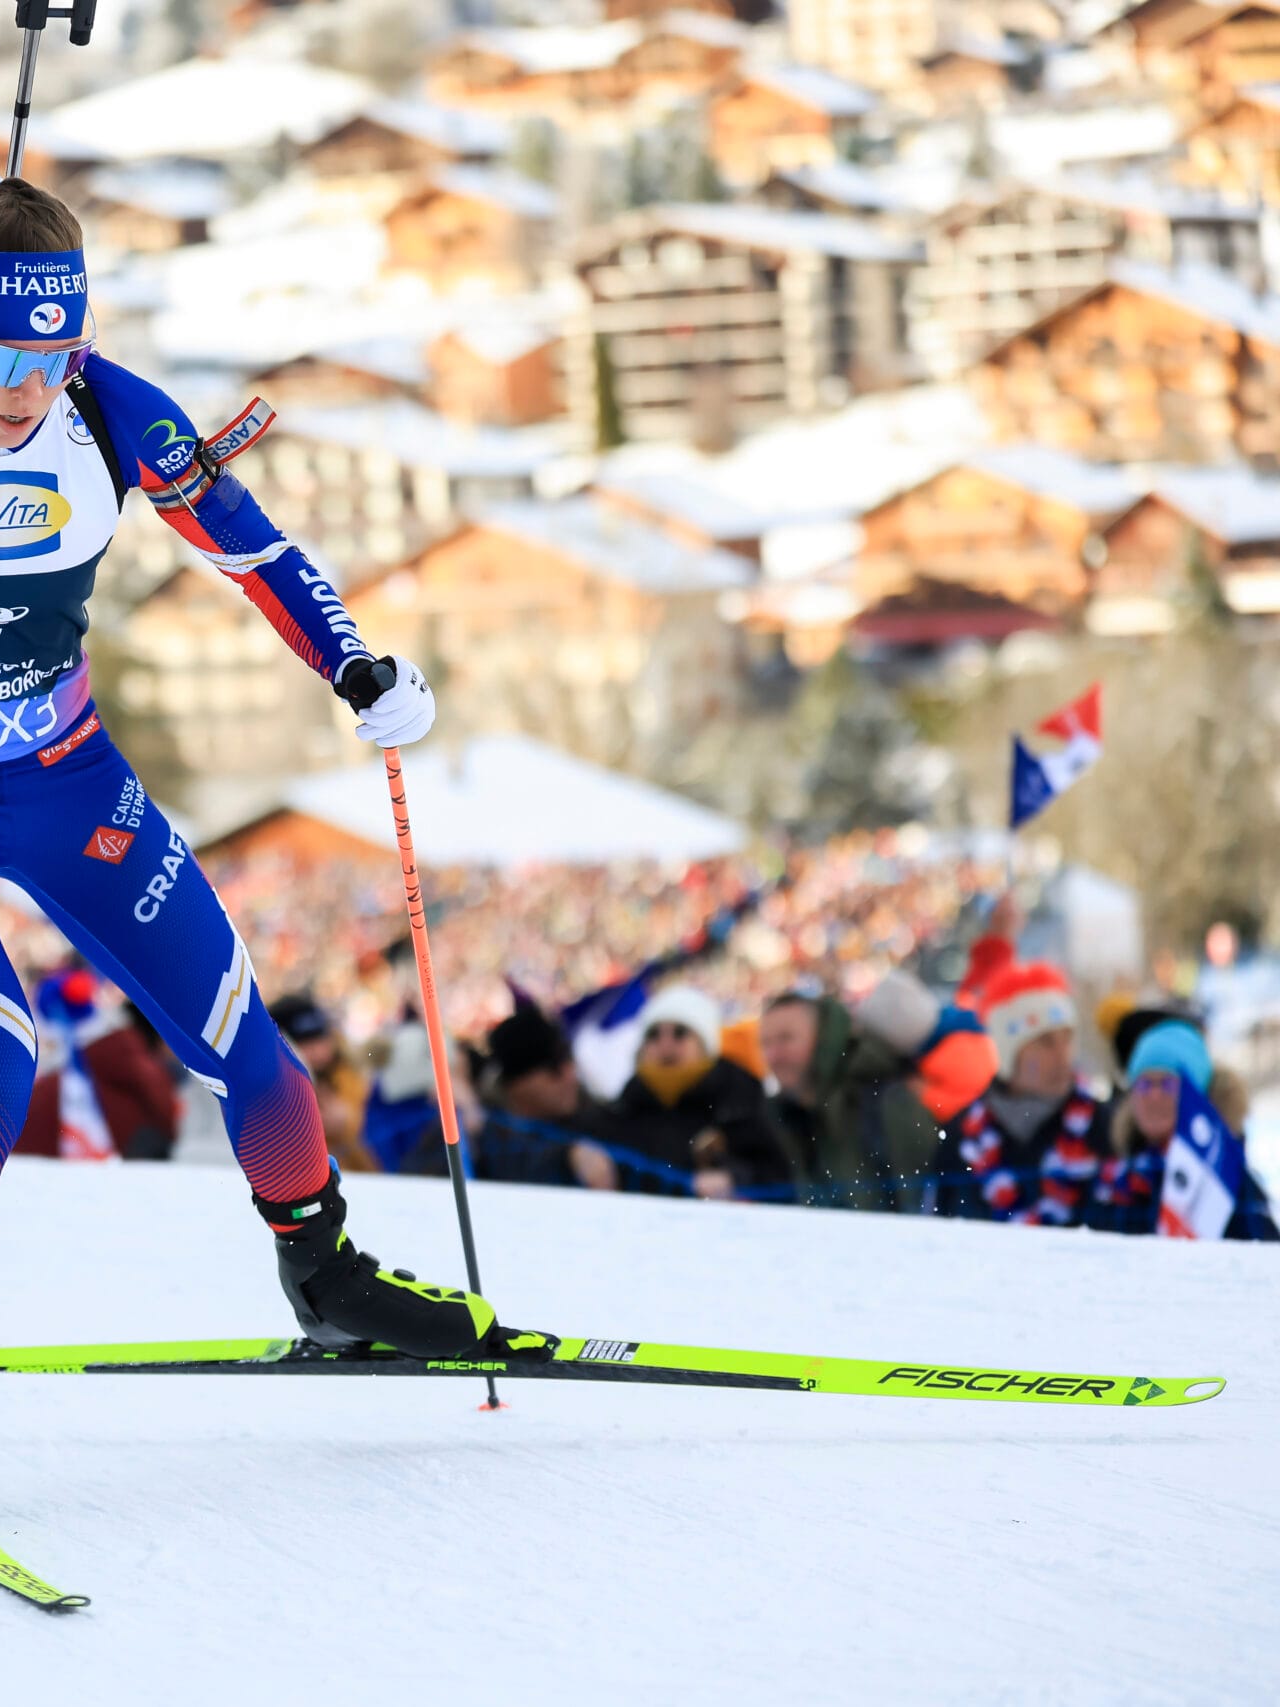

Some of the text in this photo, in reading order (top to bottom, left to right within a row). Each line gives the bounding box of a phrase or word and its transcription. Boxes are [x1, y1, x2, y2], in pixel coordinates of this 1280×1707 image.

[15, 262, 70, 274] Fruitières
[156, 443, 189, 469] ROY
[112, 776, 136, 824] CAISSE
[427, 1360, 507, 1371] FISCHER
[877, 1367, 1116, 1398] FISCHER
